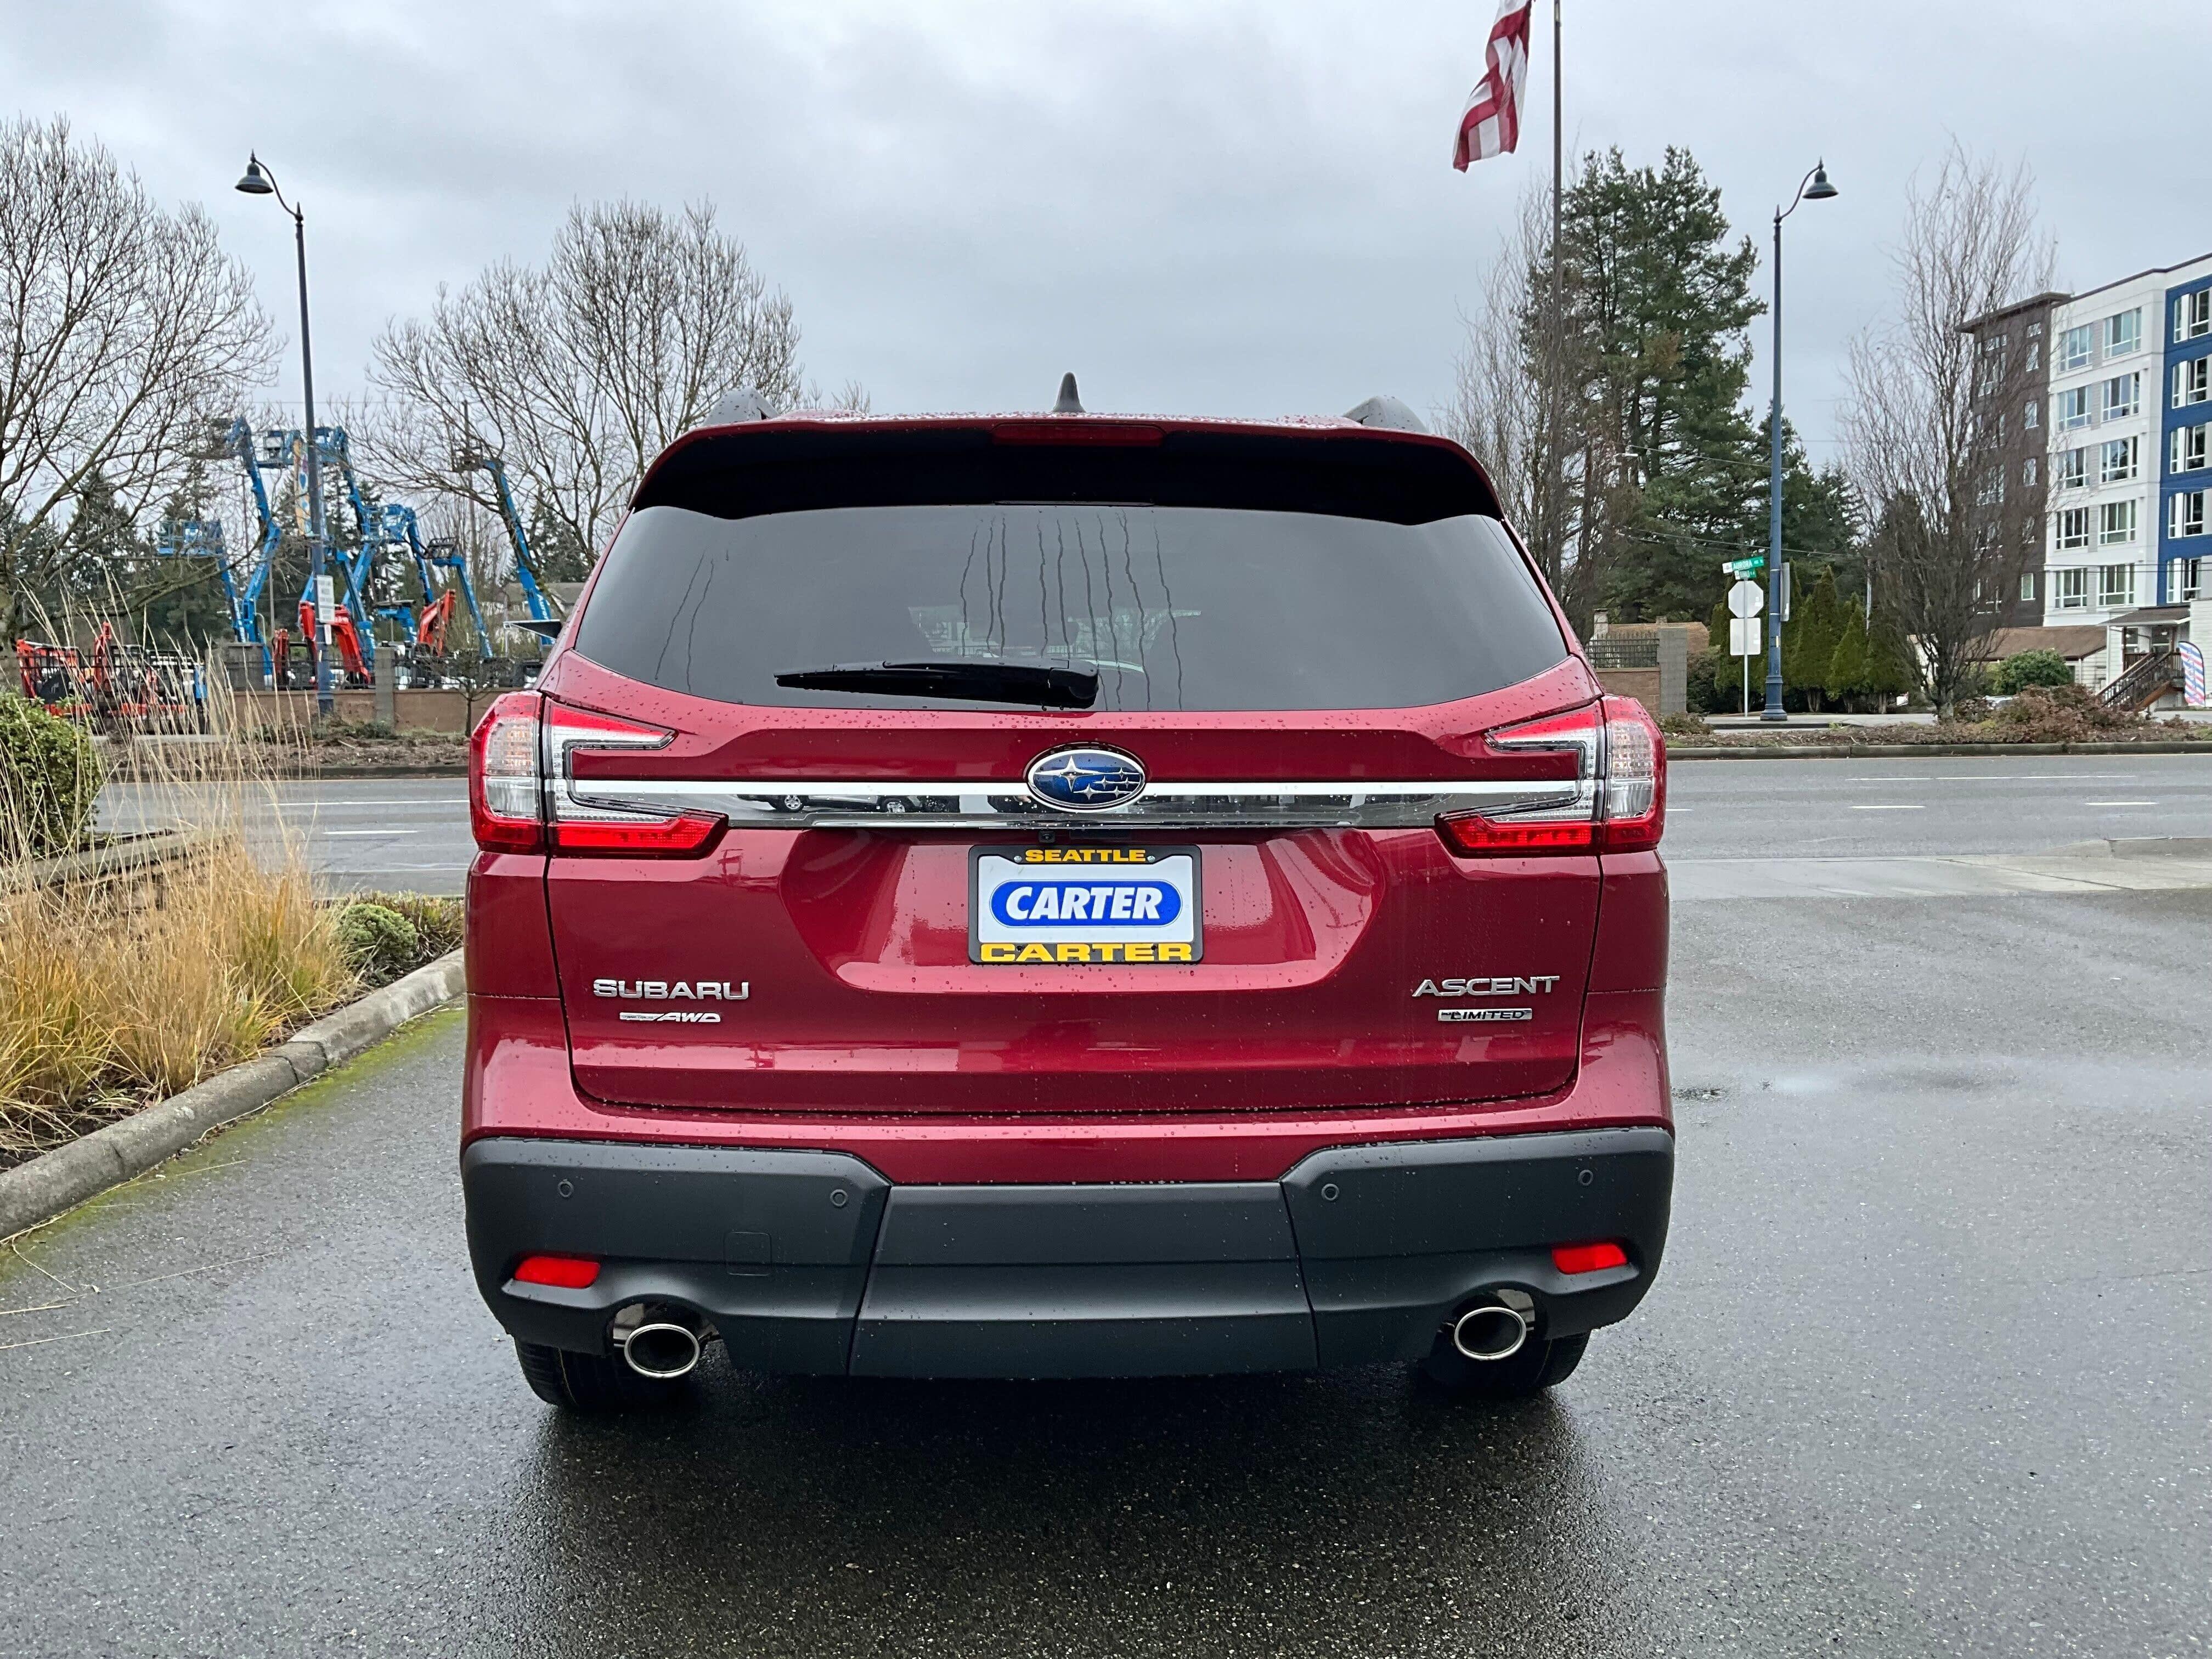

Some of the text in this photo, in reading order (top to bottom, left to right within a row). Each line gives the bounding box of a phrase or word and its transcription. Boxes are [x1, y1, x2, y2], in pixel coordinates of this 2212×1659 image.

[1733, 560, 1753, 570] AURORA
[1025, 849, 1146, 862] SEATTLE
[1006, 886, 1163, 920] CARTER
[980, 943, 1192, 962] CARTER
[593, 979, 749, 1000] SUBARU
[1412, 975, 1560, 997] ASCENT
[657, 1012, 721, 1023] AWD
[1450, 1010, 1525, 1020] LIMITED
